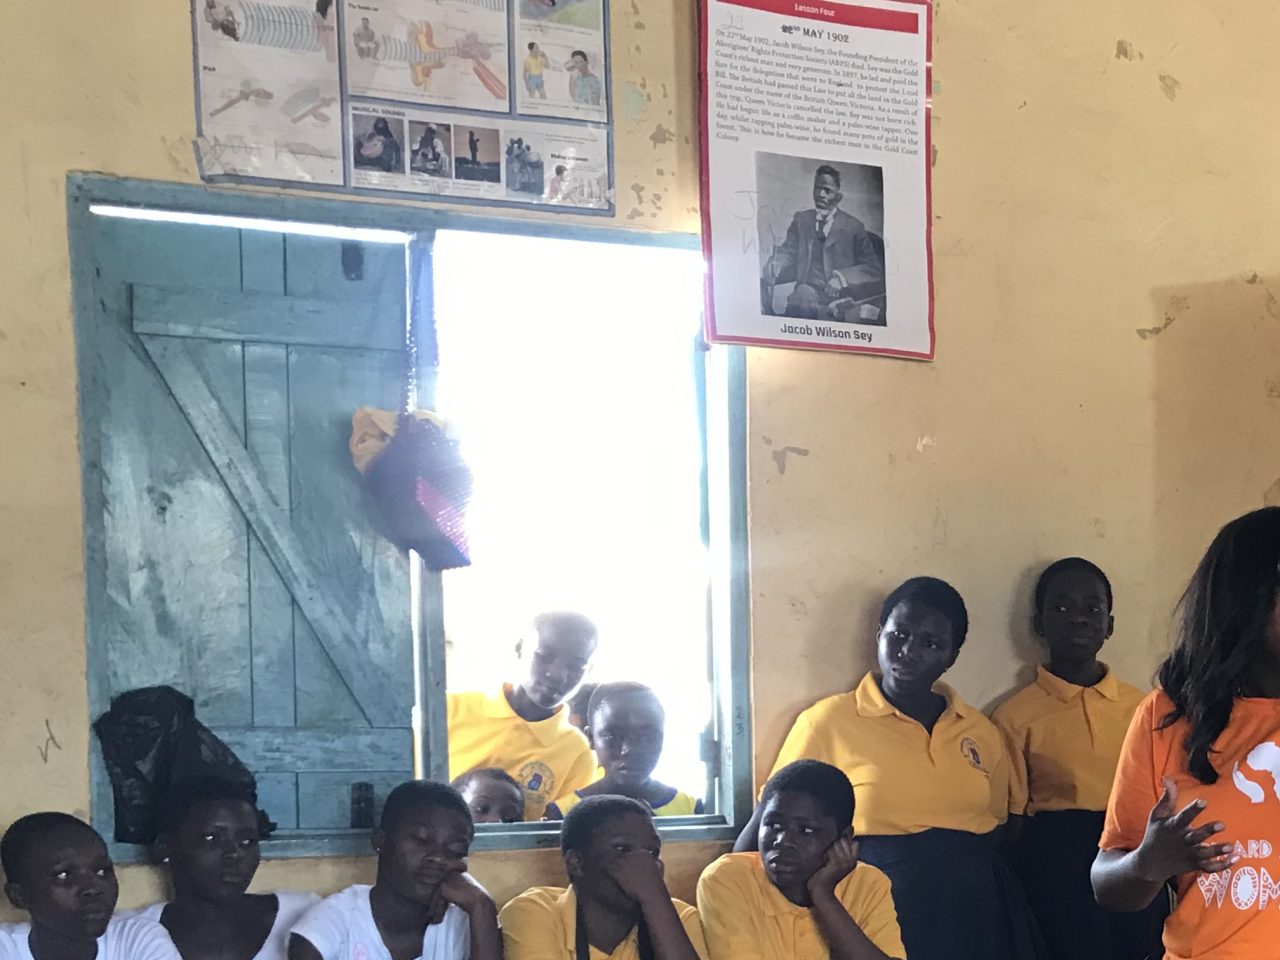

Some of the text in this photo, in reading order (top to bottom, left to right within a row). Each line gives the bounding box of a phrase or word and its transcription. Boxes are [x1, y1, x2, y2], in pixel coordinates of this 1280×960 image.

[794, 3, 835, 16] Lesson Four
[803, 27, 824, 38] MAY
[827, 32, 850, 43] 1902
[780, 324, 872, 342] Jacob Wilson Sey
